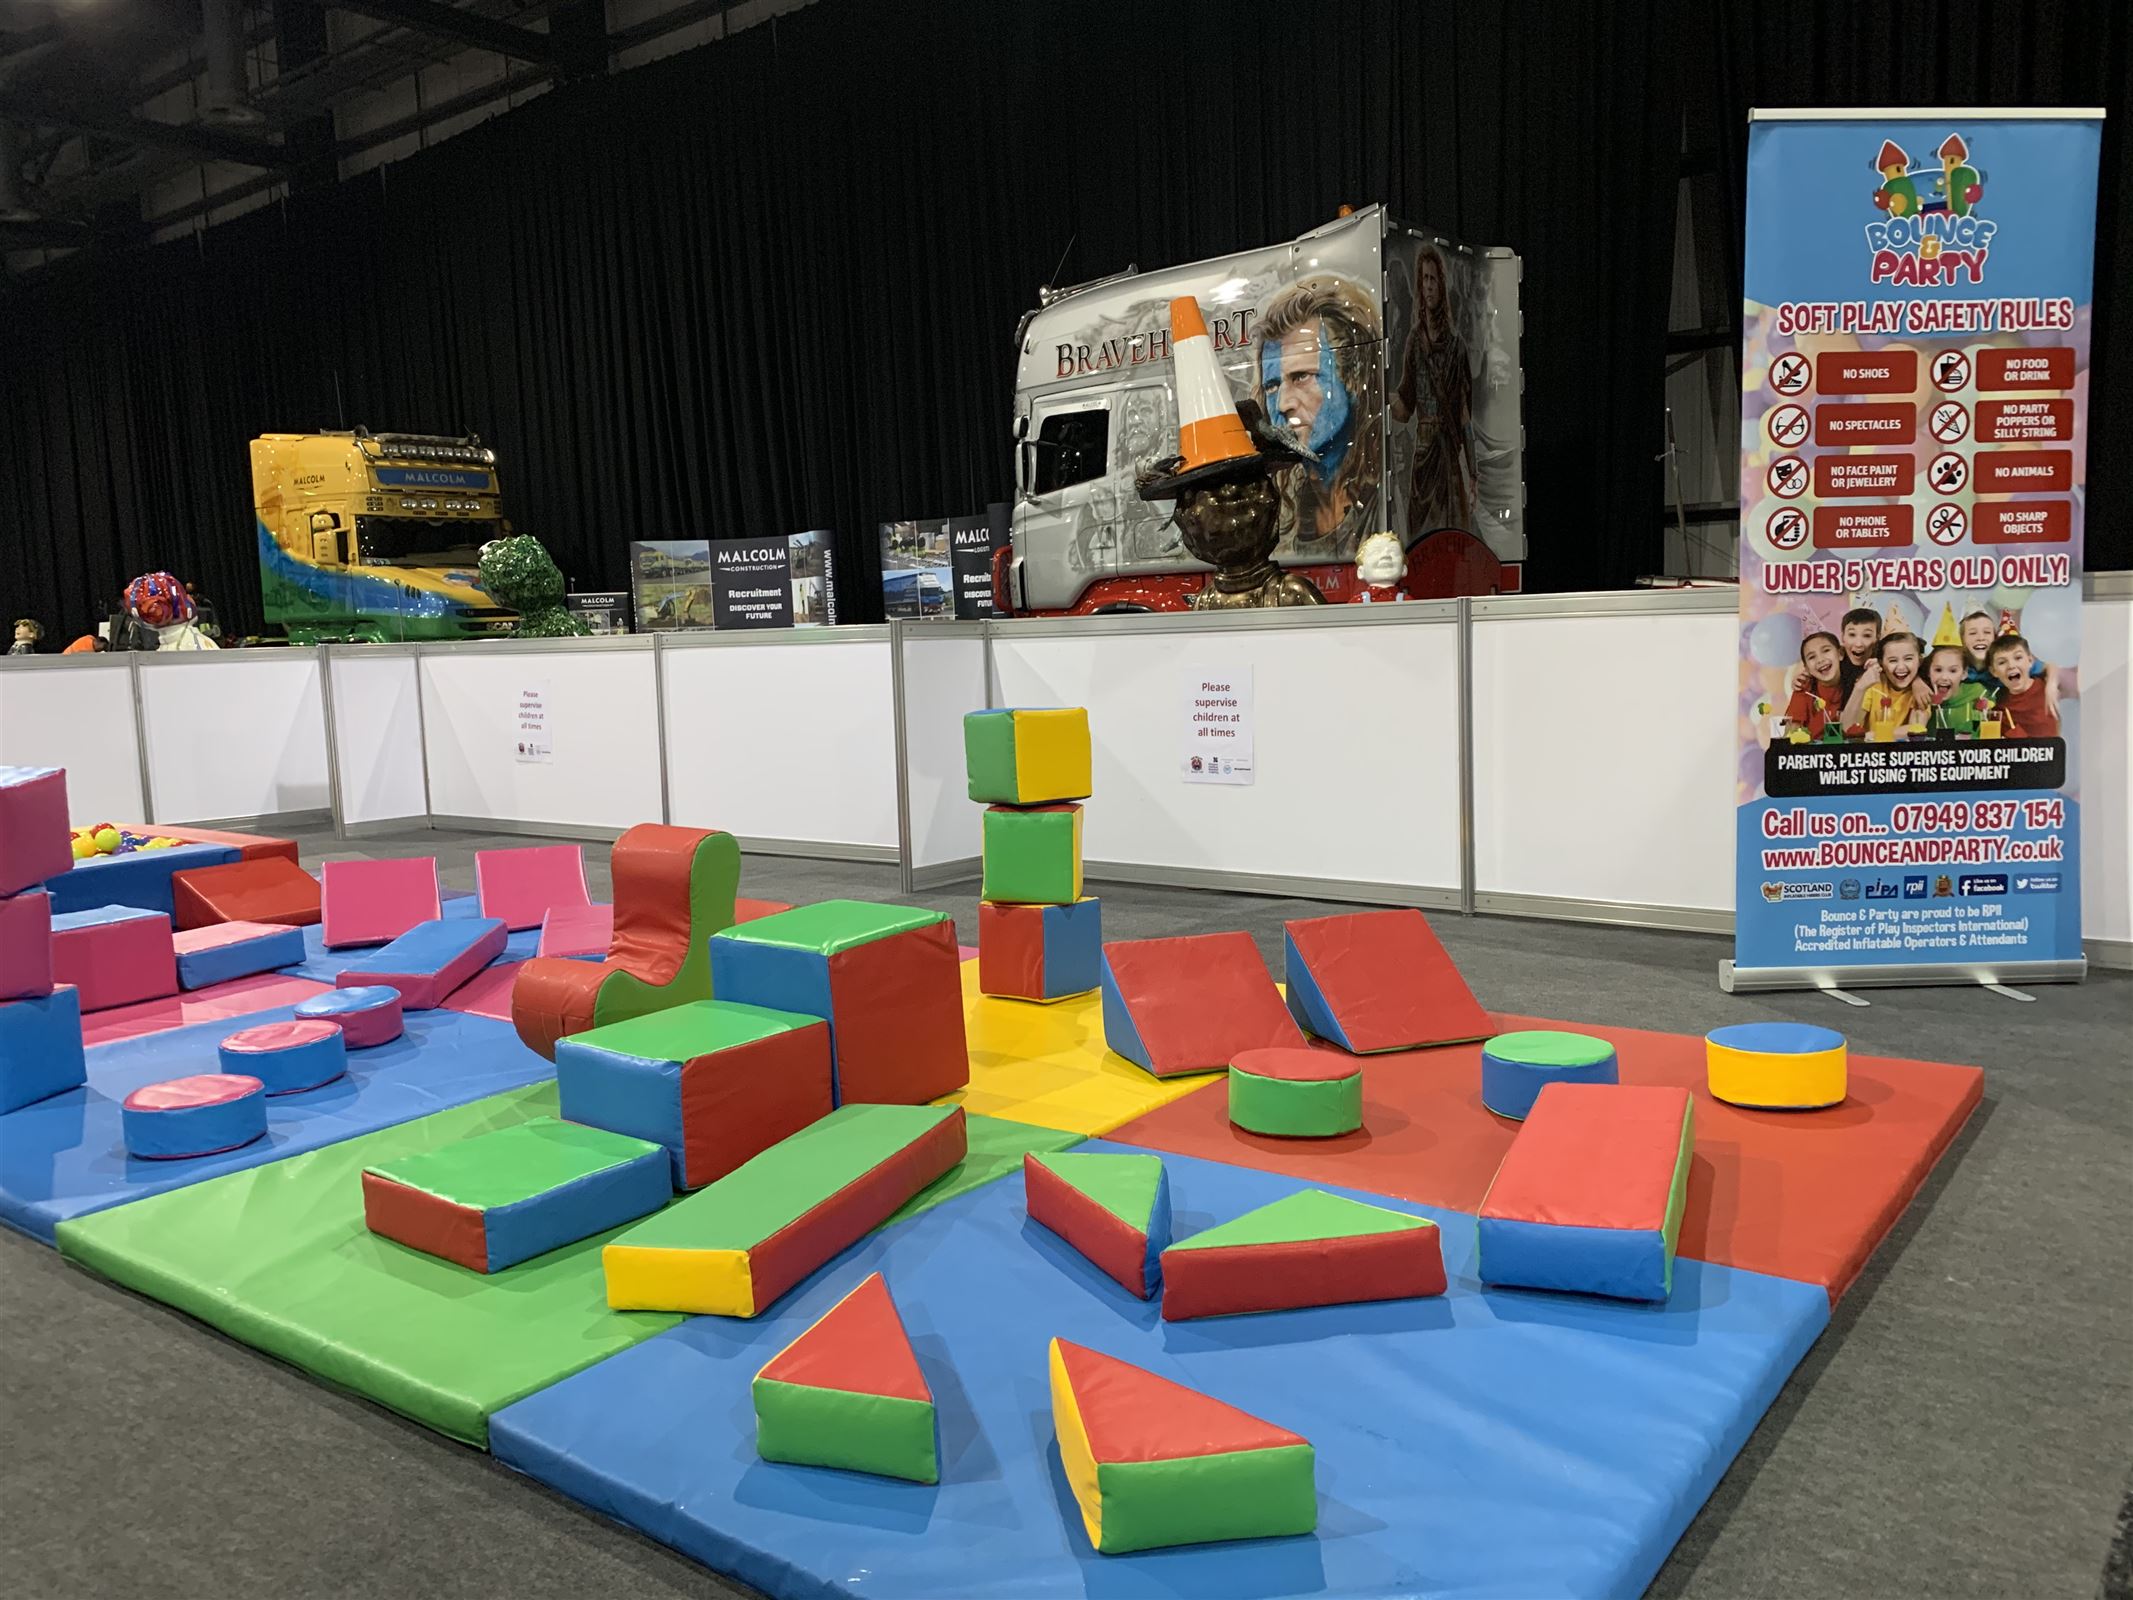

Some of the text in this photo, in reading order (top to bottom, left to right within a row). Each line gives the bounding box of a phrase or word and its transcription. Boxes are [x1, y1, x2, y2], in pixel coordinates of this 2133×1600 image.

[1866, 214, 1996, 252] BOUNCE
[1919, 235, 1941, 259] &
[1872, 250, 1988, 285] PARTY
[1779, 299, 2072, 333] SOFT PLAY SAFETY RULES
[1056, 308, 1257, 378] BRAVEHRT
[2006, 358, 2049, 369] NO FOOD
[1843, 368, 1890, 379] NO SHOES
[2004, 370, 2051, 381] OR DRINK
[2003, 404, 2050, 414] NO PARTY
[1830, 419, 1901, 431] NO SPECTACLES
[1996, 415, 2056, 426] POPPERS OR
[1994, 427, 2057, 438] SILLY STRING
[1831, 464, 1898, 476] NO FACE PAINT
[1995, 466, 2054, 477] NO ANIMALS
[294, 474, 325, 485] MALCOLM
[405, 472, 466, 484] MALCOLM
[1832, 477, 1897, 489] OR JEWELLERY
[1839, 516, 1887, 527] NO PHONE
[2000, 511, 2048, 522] NO SHARP
[1836, 528, 1890, 539] OR TABLETS
[2004, 523, 2043, 534] OBJECTS
[955, 528, 989, 544] MALC
[718, 548, 786, 563] MALCOLM
[730, 564, 777, 572] CONSTRUCTION
[1765, 555, 2069, 590] UNDER 5 YEARS OLD ONLY!
[728, 588, 782, 599] Recruitment
[729, 602, 782, 612] DISCOVER YOUR
[746, 612, 772, 620] FUTURE
[1202, 682, 1231, 692] Please
[1195, 698, 1237, 708] supervise
[1193, 713, 1240, 722] children at
[1198, 728, 1236, 737] all times
[1778, 747, 2054, 770] PARENTS, PLEASE SUPERVISE YOUR CHILDREN
[1820, 765, 2011, 785] WHILST USING THIS EQUIPMENT
[1764, 800, 2063, 836] Call us on... 07949 837 154
[1764, 838, 2061, 868] www.BOUNCEANDPARTY.co.uk
[1784, 884, 1832, 894] SCOTLAND
[1973, 884, 2004, 892] facebook
[1821, 909, 1856, 922] Bounce
[1859, 909, 1866, 920] &
[1869, 908, 1899, 922] Party
[1901, 910, 1919, 919] are
[1921, 906, 1952, 921] proud
[1954, 906, 1965, 917] to
[1967, 906, 1980, 917] be
[1794, 917, 2029, 939] (The Register of Play Inspectors International)
[1794, 933, 2028, 952] Accredited Inflatable Operators & Attendants
